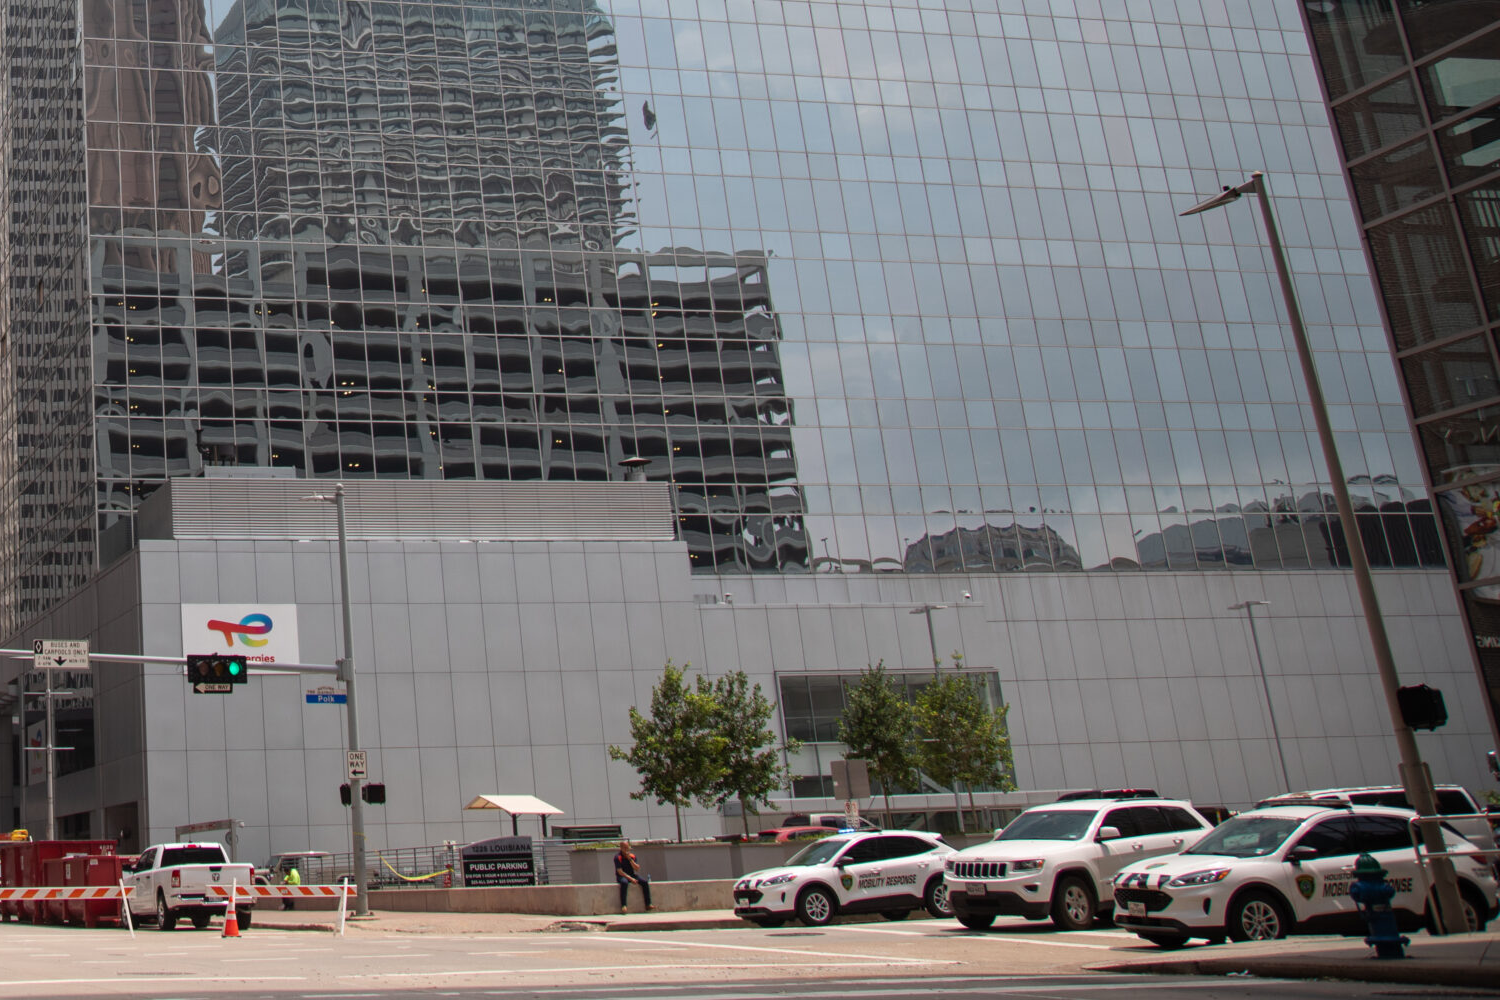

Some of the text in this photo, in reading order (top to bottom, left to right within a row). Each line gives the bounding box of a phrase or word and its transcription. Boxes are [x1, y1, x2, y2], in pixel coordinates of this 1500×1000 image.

[317, 695, 334, 703] Polk
[490, 843, 531, 852] LOUISIANA
[469, 862, 528, 871] PUBLIC PARKING
[858, 874, 917, 889] MOBILITY RESPONSE
[1322, 877, 1413, 898] MOBIL ONSE
